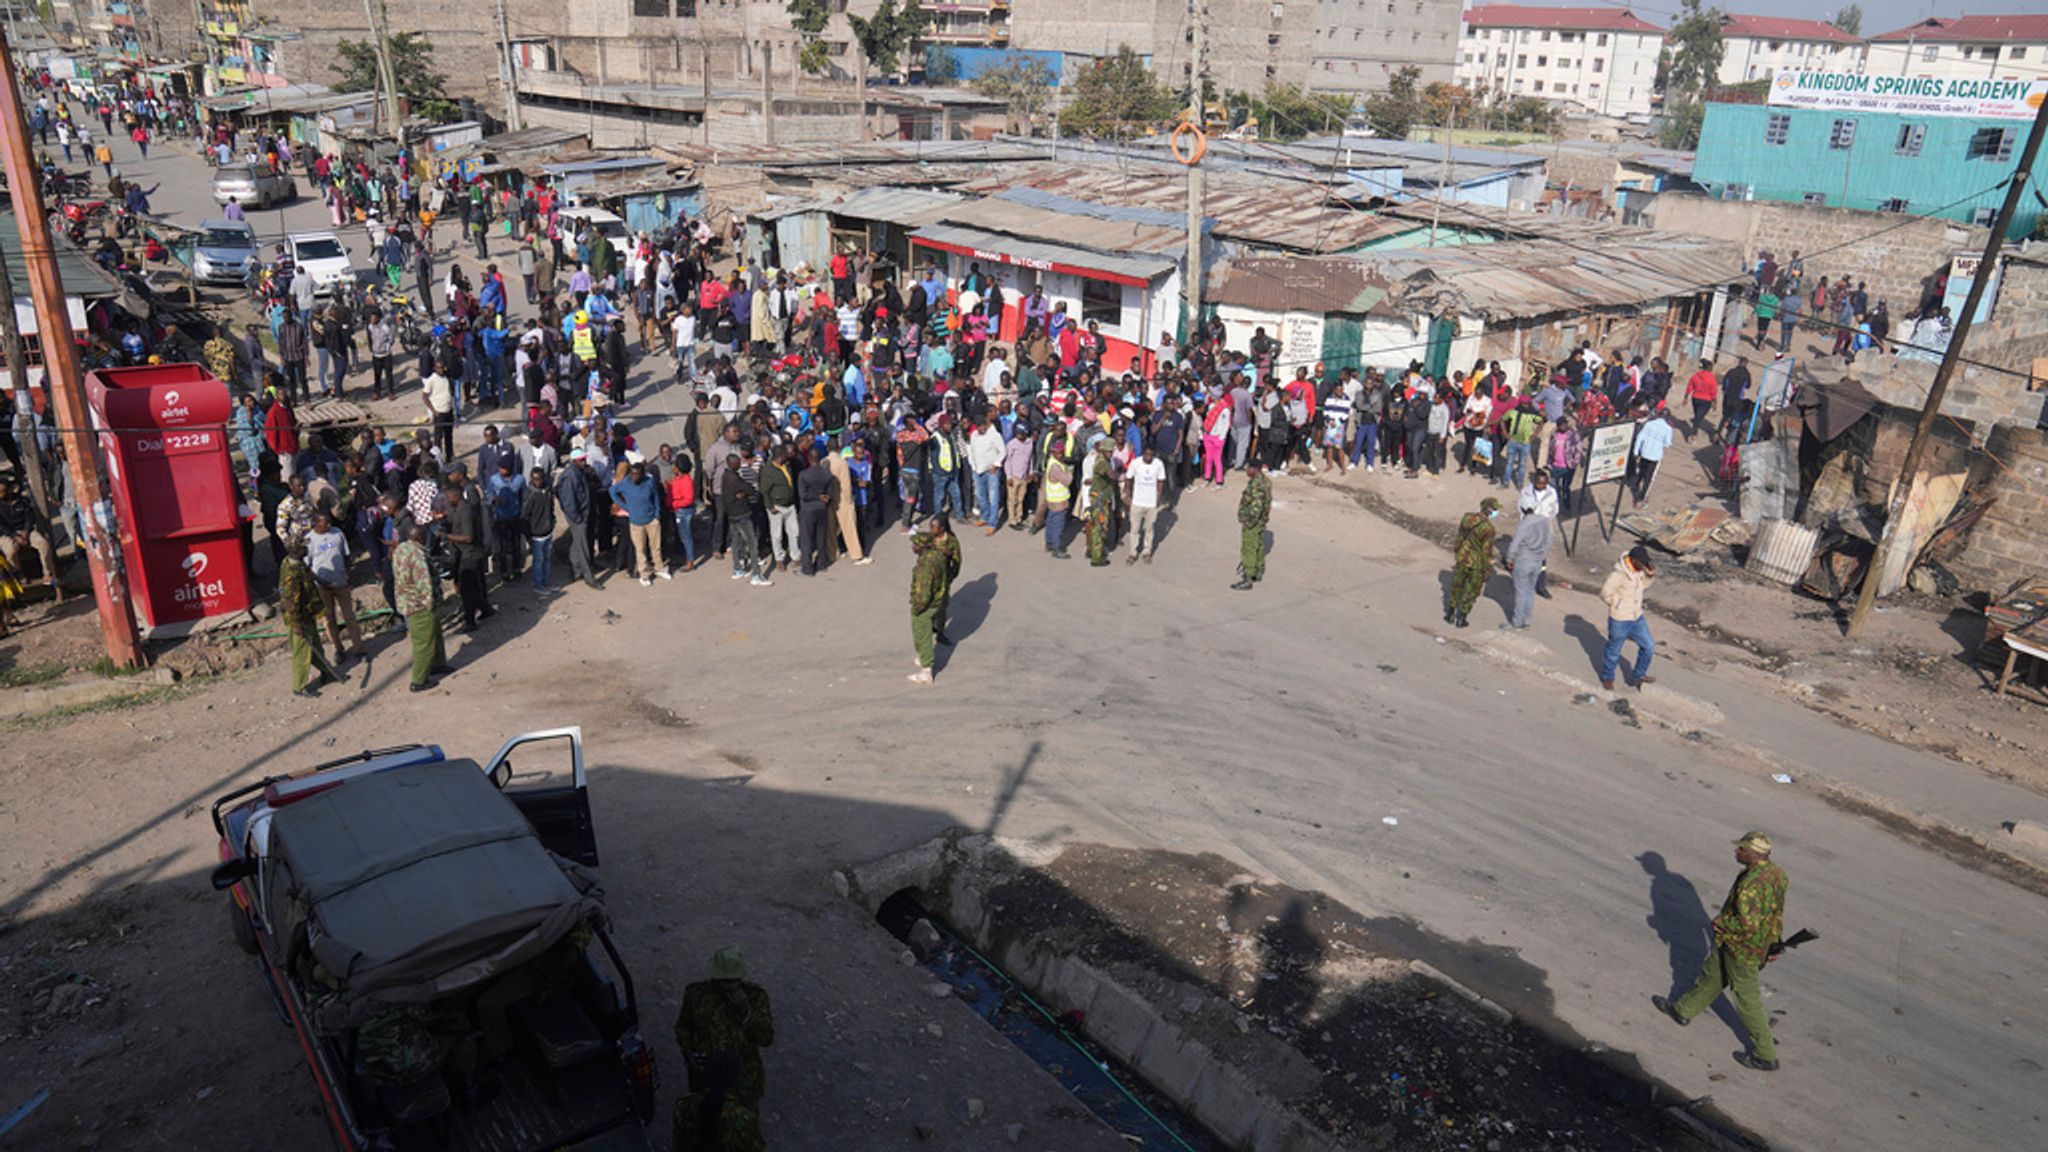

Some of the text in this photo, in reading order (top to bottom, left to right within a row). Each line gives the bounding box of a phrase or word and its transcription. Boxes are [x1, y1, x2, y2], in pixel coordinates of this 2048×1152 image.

[1798, 72, 2032, 100] KINGDOM SPRINGS ACADEMY
[161, 406, 190, 418] airtel
[137, 438, 163, 451] Dial
[174, 579, 225, 601] airtel
[184, 599, 220, 611] money
